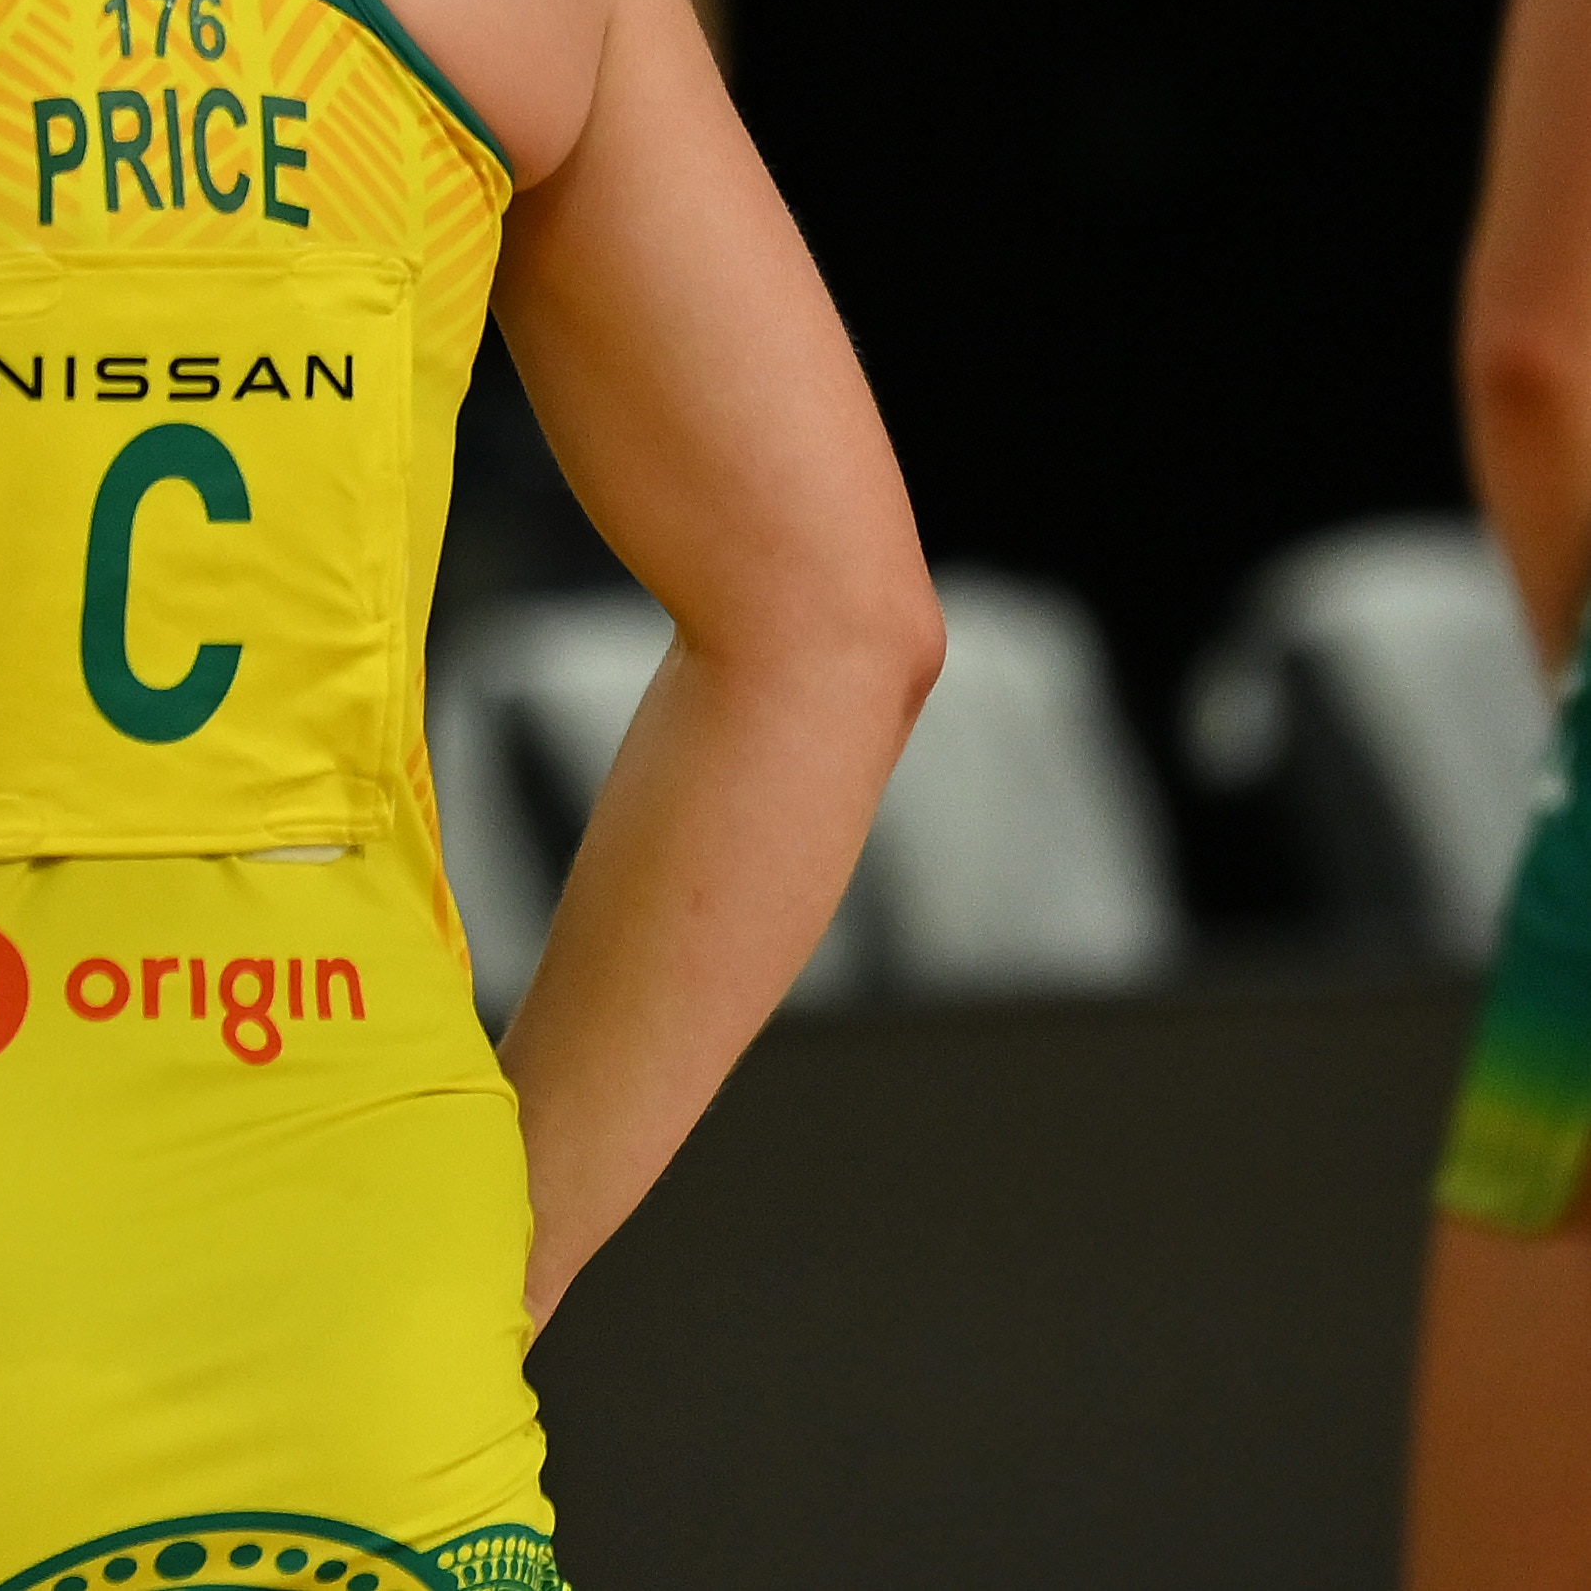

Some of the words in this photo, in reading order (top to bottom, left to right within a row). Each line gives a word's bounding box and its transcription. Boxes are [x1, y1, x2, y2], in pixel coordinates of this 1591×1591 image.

[32, 86, 312, 230] PRICE
[79, 421, 253, 745] C
[64, 956, 367, 1067] origin
